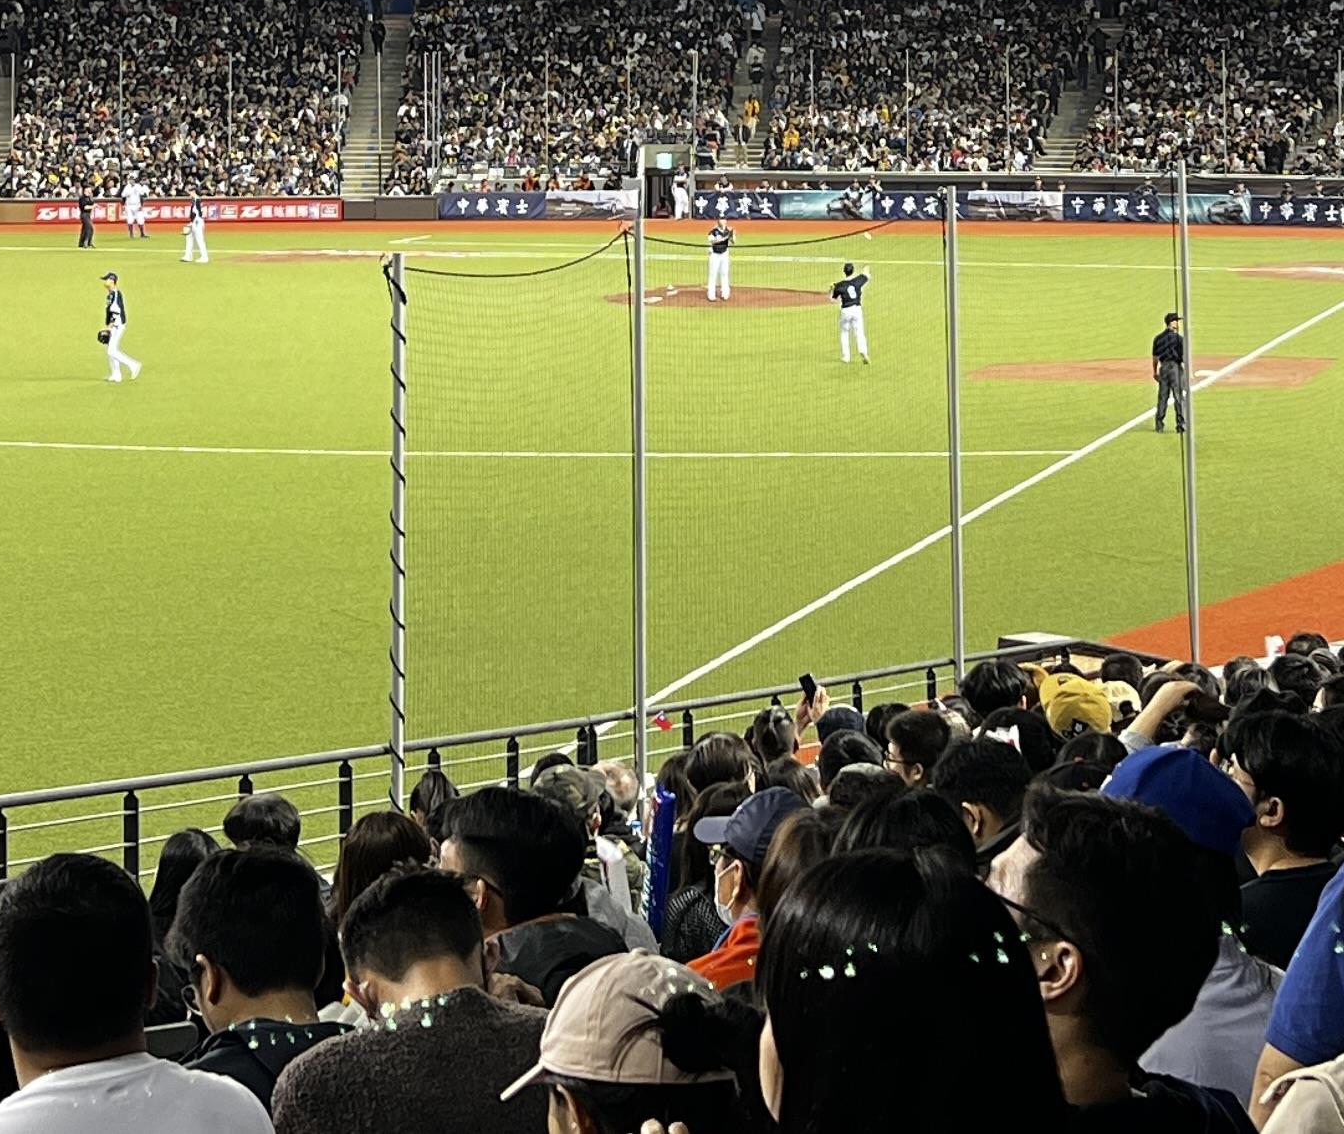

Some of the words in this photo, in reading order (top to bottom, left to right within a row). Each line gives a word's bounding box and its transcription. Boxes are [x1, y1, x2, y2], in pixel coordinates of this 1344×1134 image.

[457, 196, 529, 215] 中華賓士
[1071, 196, 1150, 217] 中華賓士
[1259, 201, 1343, 223] 中華賓士
